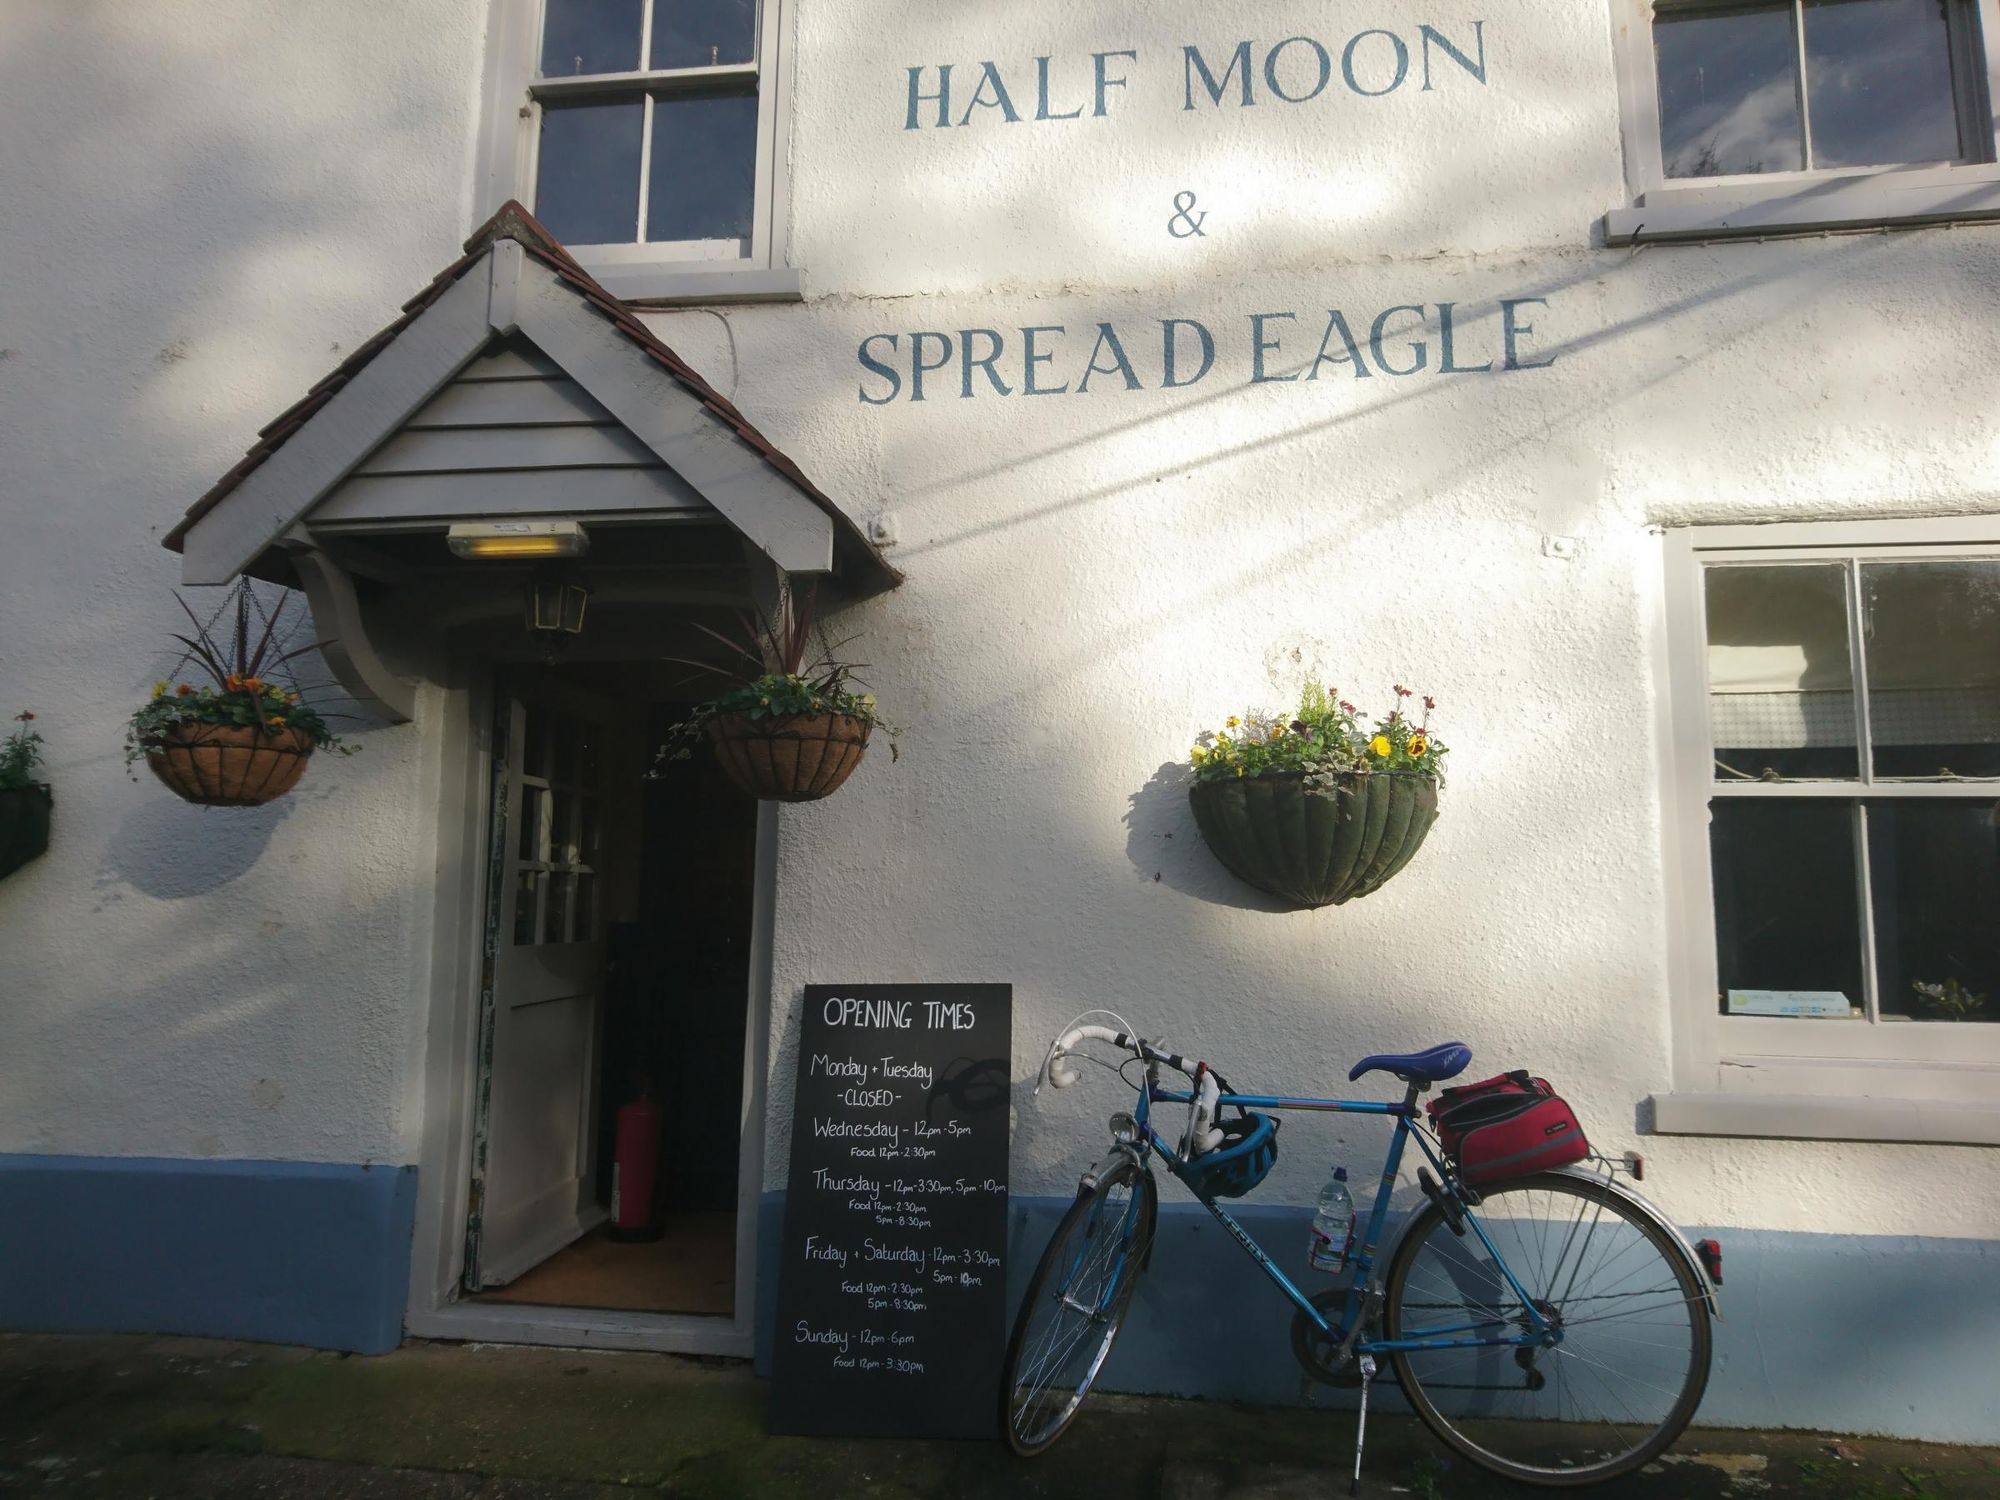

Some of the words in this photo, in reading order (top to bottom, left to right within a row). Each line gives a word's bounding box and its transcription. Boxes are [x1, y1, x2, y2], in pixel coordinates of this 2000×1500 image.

[903, 50, 1137, 130] HALF
[1181, 20, 1487, 111] MOON
[1167, 190, 1208, 239] &
[858, 317, 1216, 405] SPREAD
[1249, 298, 1557, 384] EAGLE
[823, 997, 913, 1029] OPENING
[922, 1001, 976, 1030] TIMES
[810, 1053, 868, 1086] Monday
[880, 1056, 933, 1090] Tuesday
[814, 1117, 899, 1149] Wednesday
[850, 1147, 876, 1158] Food
[812, 1167, 881, 1201] Thursday
[848, 1199, 872, 1211] Food
[804, 1235, 848, 1269] Friday
[863, 1237, 926, 1274] Saturday
[841, 1280, 864, 1294] Food
[795, 1319, 849, 1354] Sunday
[832, 1355, 856, 1368] Food
